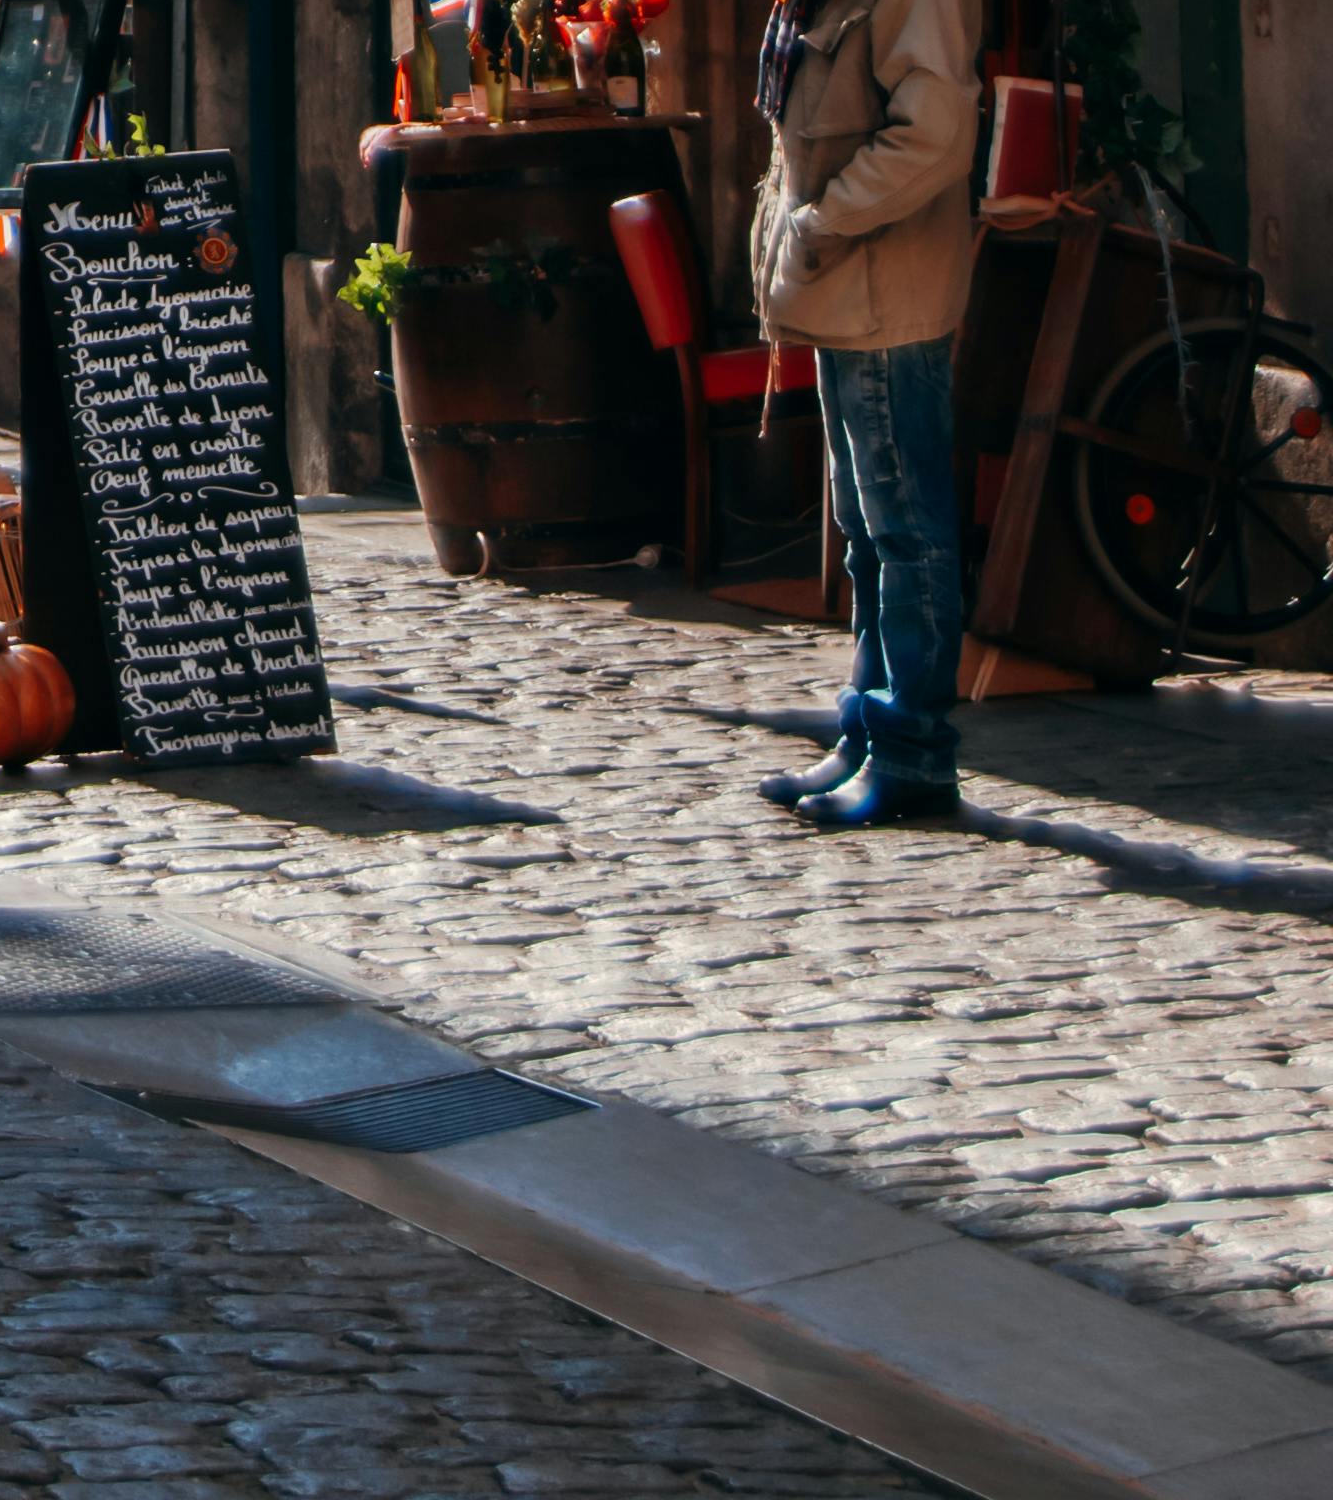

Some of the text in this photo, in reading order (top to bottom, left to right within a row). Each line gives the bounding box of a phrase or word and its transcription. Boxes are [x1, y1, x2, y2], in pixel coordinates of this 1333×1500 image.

[43, 201, 134, 233] Menu
[40, 241, 179, 283] Bouchon
[64, 281, 254, 319] Salade Lyonnaise
[67, 305, 252, 347] Saucisson brioché
[70, 335, 250, 379] Soupe à l'oignon
[75, 362, 269, 408] Cervelle des Canuts
[73, 395, 273, 438] Rosette de Lyon
[83, 428, 265, 467] Pâté en croûte
[162, 453, 261, 479] meurette
[98, 504, 296, 543] Tablier de sapeur
[103, 547, 175, 580] Tripes
[177, 550, 193, 565] à
[192, 540, 216, 559] la
[112, 565, 289, 609] Soupe à l'oignon
[120, 616, 307, 661] Saucisson chaud
[120, 658, 217, 690] Quenelles
[221, 658, 245, 675] de
[122, 687, 224, 720] Bavette
